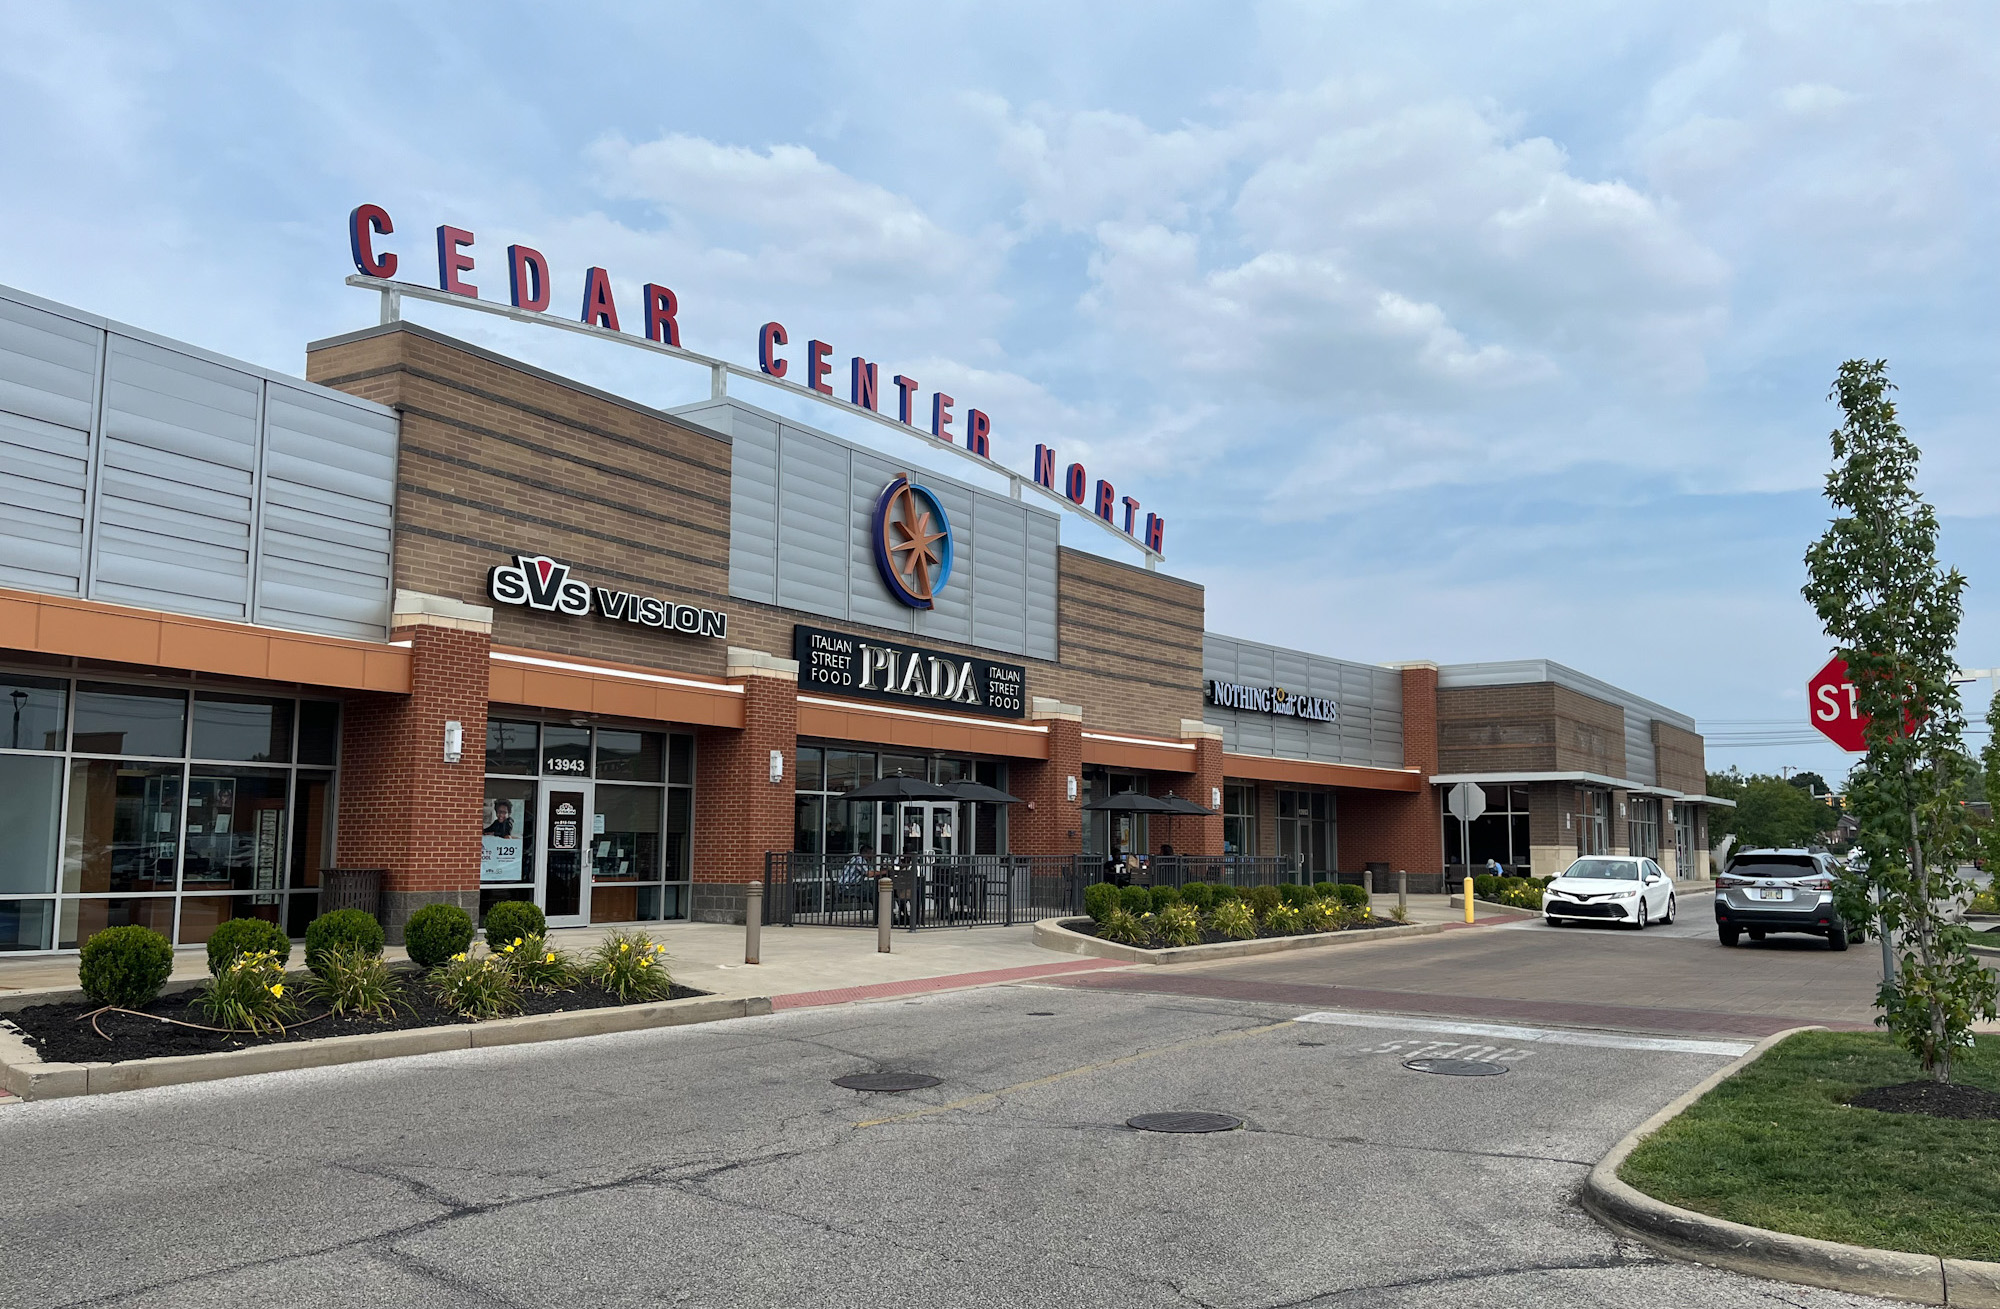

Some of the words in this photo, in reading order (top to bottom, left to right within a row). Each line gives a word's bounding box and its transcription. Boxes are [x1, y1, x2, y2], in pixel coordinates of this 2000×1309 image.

[349, 203, 682, 348] CEDAR
[758, 321, 991, 459] CENTER
[1034, 443, 1166, 554] NORTH
[596, 587, 727, 639] VISION
[811, 634, 852, 653] ITALIAN
[811, 651, 852, 670] STREET
[811, 667, 852, 686] FOOD
[858, 643, 983, 706] PIADA
[989, 666, 1020, 683] ITALIAN
[989, 680, 1019, 697] STREET
[989, 694, 1020, 710] FOOD
[1213, 680, 1271, 713] NOTHING
[1297, 695, 1337, 722] CAKES
[547, 757, 585, 772] 13943
[1358, 1039, 1537, 1062] STOP
